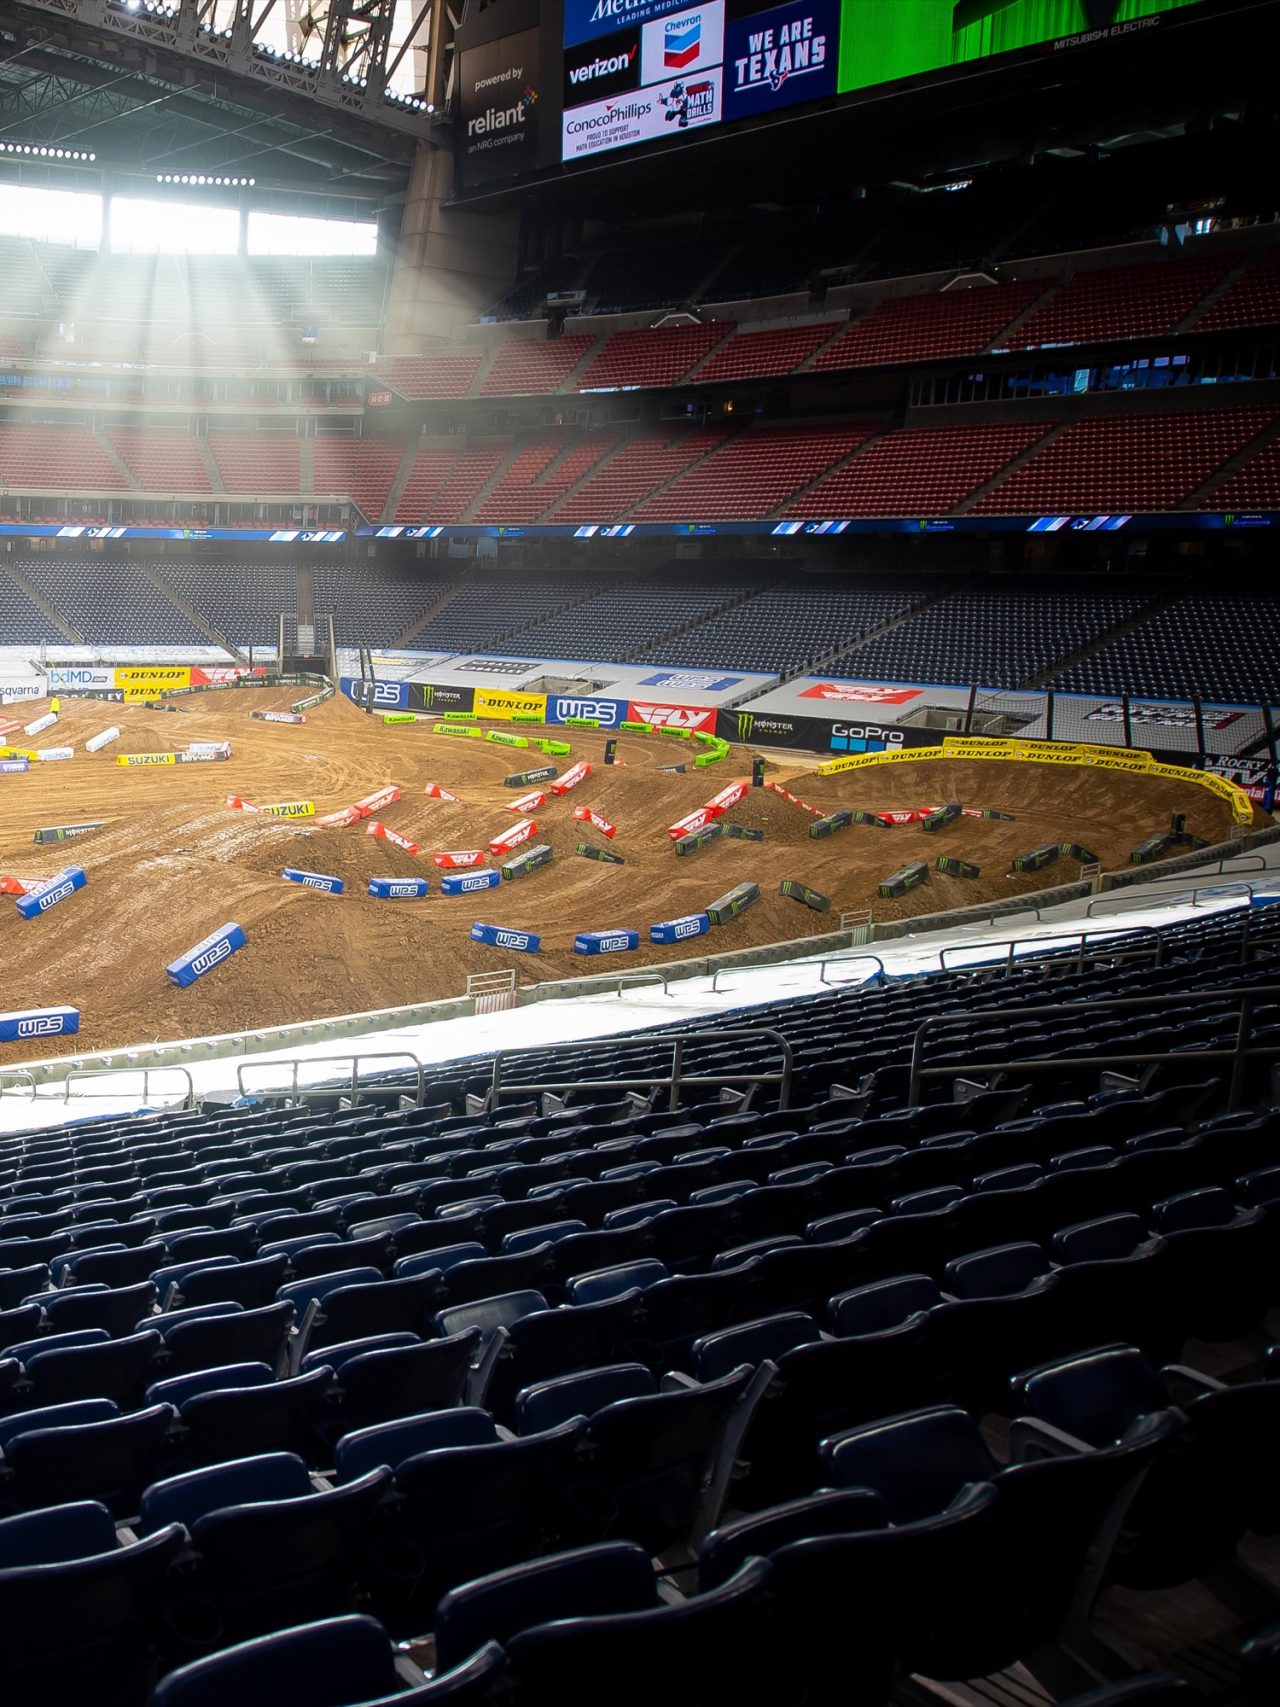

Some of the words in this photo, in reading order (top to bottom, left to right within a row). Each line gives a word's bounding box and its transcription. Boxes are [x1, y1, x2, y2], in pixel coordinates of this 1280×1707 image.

[665, 15, 702, 33] Chevron
[749, 29, 774, 54] WE
[780, 17, 813, 45] ARE
[1053, 28, 1108, 50] MITSUBISHI
[1110, 15, 1160, 36] ELECTRIC
[735, 35, 826, 85] TEXANS
[570, 54, 630, 85] verizon
[475, 69, 511, 92] powered
[513, 67, 523, 79] by
[687, 89, 713, 108] MATH
[468, 101, 526, 136] reliant
[567, 103, 652, 135] ConocoPhillips
[687, 103, 713, 119] DRILLS
[477, 138, 493, 150] NRG
[494, 132, 525, 148] company
[434, 691, 461, 700] MONSTER
[487, 698, 543, 711] DUNLOP
[556, 699, 617, 725] WPS
[645, 705, 711, 728] FLY
[439, 725, 469, 735] Kawasaki
[754, 719, 793, 731] MONSTER
[832, 723, 904, 742] GoPro
[491, 733, 516, 745] Kawasaki
[128, 755, 170, 765] SUZUKI
[891, 750, 942, 760] DUNLOP
[1026, 753, 1082, 762] DUNLOP
[1098, 749, 1140, 759] DUNLOP
[834, 757, 877, 771] DUNLOP
[1095, 760, 1147, 770] DUNLOP
[1217, 756, 1266, 769] ROCKY
[1160, 768, 1204, 780] DUNLOP
[449, 852, 480, 865] FLY
[302, 876, 332, 892] WPS
[390, 885, 418, 897] WPS
[461, 876, 490, 891] WPS
[39, 881, 75, 911] WPS
[674, 918, 700, 938] WPS
[496, 932, 530, 950] WPS
[600, 936, 629, 951] WPS
[191, 939, 232, 976] WPS
[18, 1016, 63, 1037] WPS
